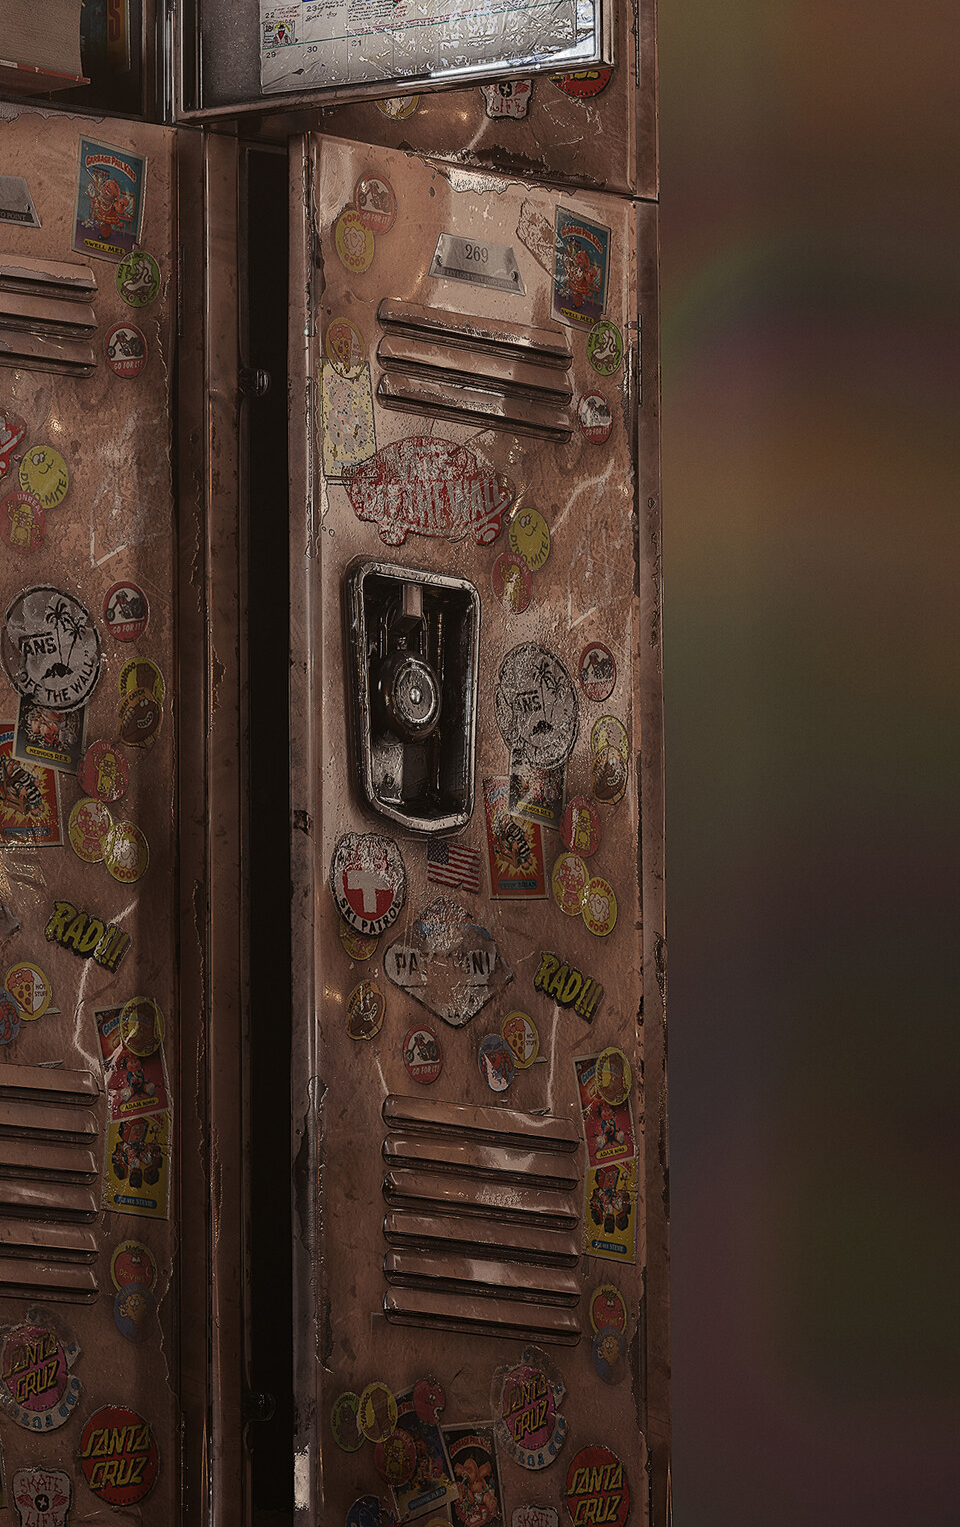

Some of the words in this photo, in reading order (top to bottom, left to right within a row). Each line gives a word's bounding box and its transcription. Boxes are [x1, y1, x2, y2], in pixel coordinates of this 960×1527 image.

[306, 5, 317, 13] 23
[488, 96, 526, 115] LIFE
[85, 154, 112, 168] GARBAGE
[111, 156, 125, 171] PAIL
[124, 162, 138, 183] KIDS
[6, 212, 26, 221] POINT
[84, 239, 108, 251] SWELL
[108, 244, 126, 255] MEL
[464, 244, 489, 263] 269
[344, 253, 366, 267] GOOD
[580, 314, 595, 324] MEL
[113, 362, 122, 371] GO
[122, 361, 134, 370] FOR
[112, 625, 121, 634] GO
[121, 624, 133, 633] FOR
[44, 686, 71, 703] THE
[54, 751, 69, 763] REX
[113, 865, 139, 880] GOOD
[340, 899, 357, 924] SKI
[589, 918, 610, 933] GOOD
[45, 901, 130, 970] RAD!!!
[535, 952, 604, 1019] RAD!!!
[411, 1067, 421, 1076] GO
[421, 1066, 431, 1075] FOR
[124, 1102, 142, 1110] ADAM
[2, 1334, 59, 1379] SANTA
[15, 1360, 60, 1405] CRUZ
[502, 1373, 548, 1418] SANTA
[513, 1399, 549, 1442] CRUZ
[81, 1425, 151, 1458] SANTA
[89, 1456, 149, 1490] CRUZ
[565, 1462, 624, 1496] SANTA
[20, 1475, 63, 1495] SKATE
[25, 1511, 61, 1527] LIFE
[573, 1495, 622, 1525] CRUZ
